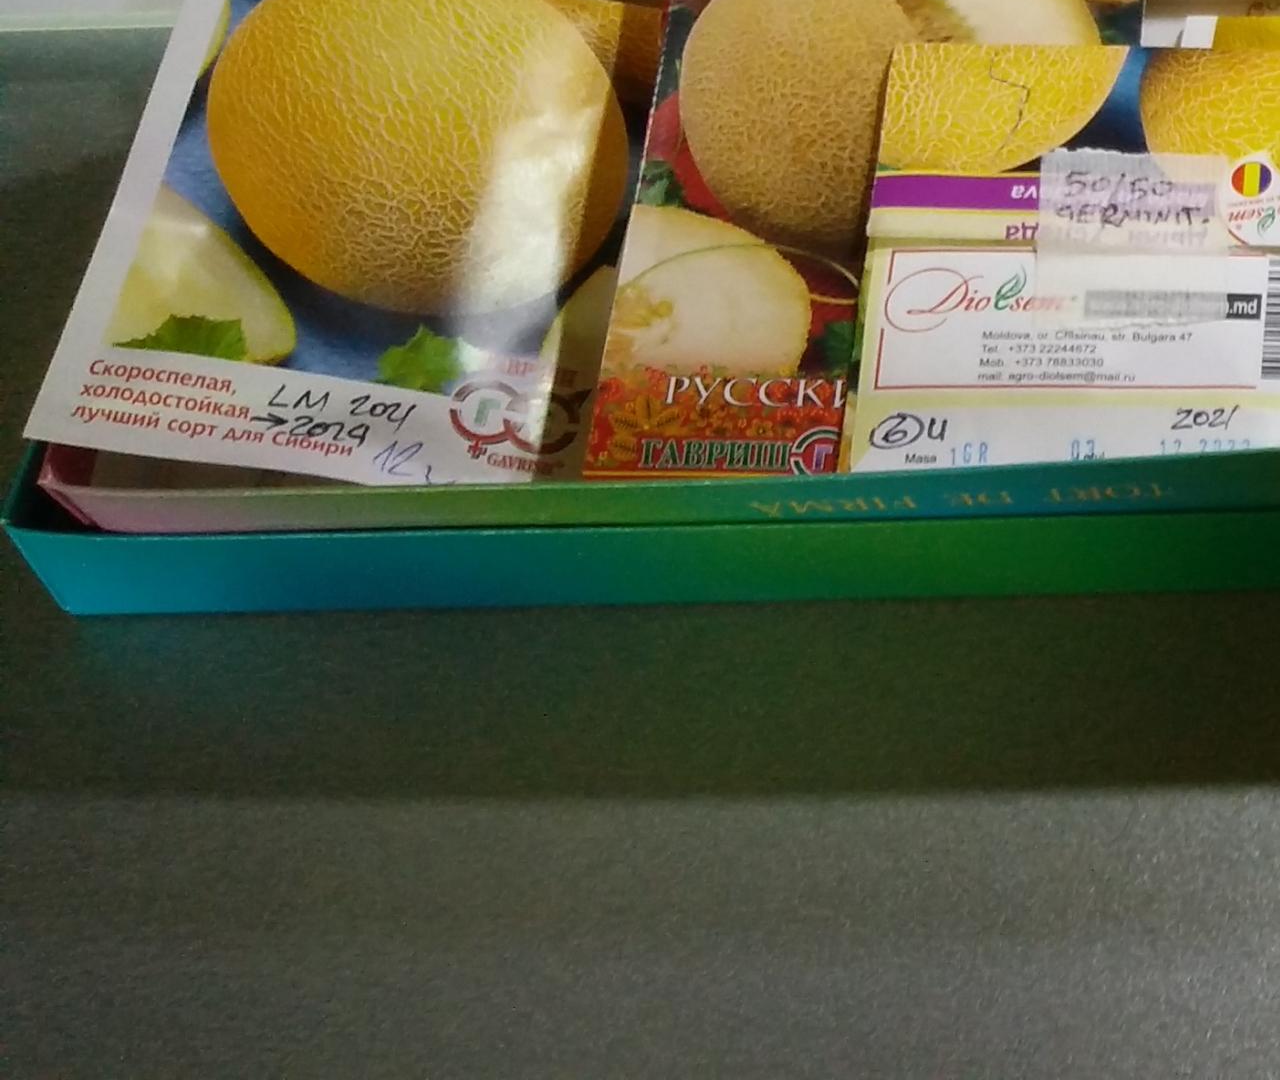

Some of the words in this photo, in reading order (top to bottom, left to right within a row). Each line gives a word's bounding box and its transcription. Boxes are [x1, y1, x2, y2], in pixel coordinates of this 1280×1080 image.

[1178, 331, 1194, 342] 47
[88, 358, 237, 397] Скороспелая,
[79, 382, 250, 421] холодостойкая
[70, 403, 160, 430] лучший
[166, 417, 218, 440] сорт
[221, 427, 264, 444] для
[271, 429, 355, 458] Сибири
[1170, 404, 1240, 432] 2021
[638, 438, 793, 470] ГАВРИШ
[904, 452, 937, 465] Masa
